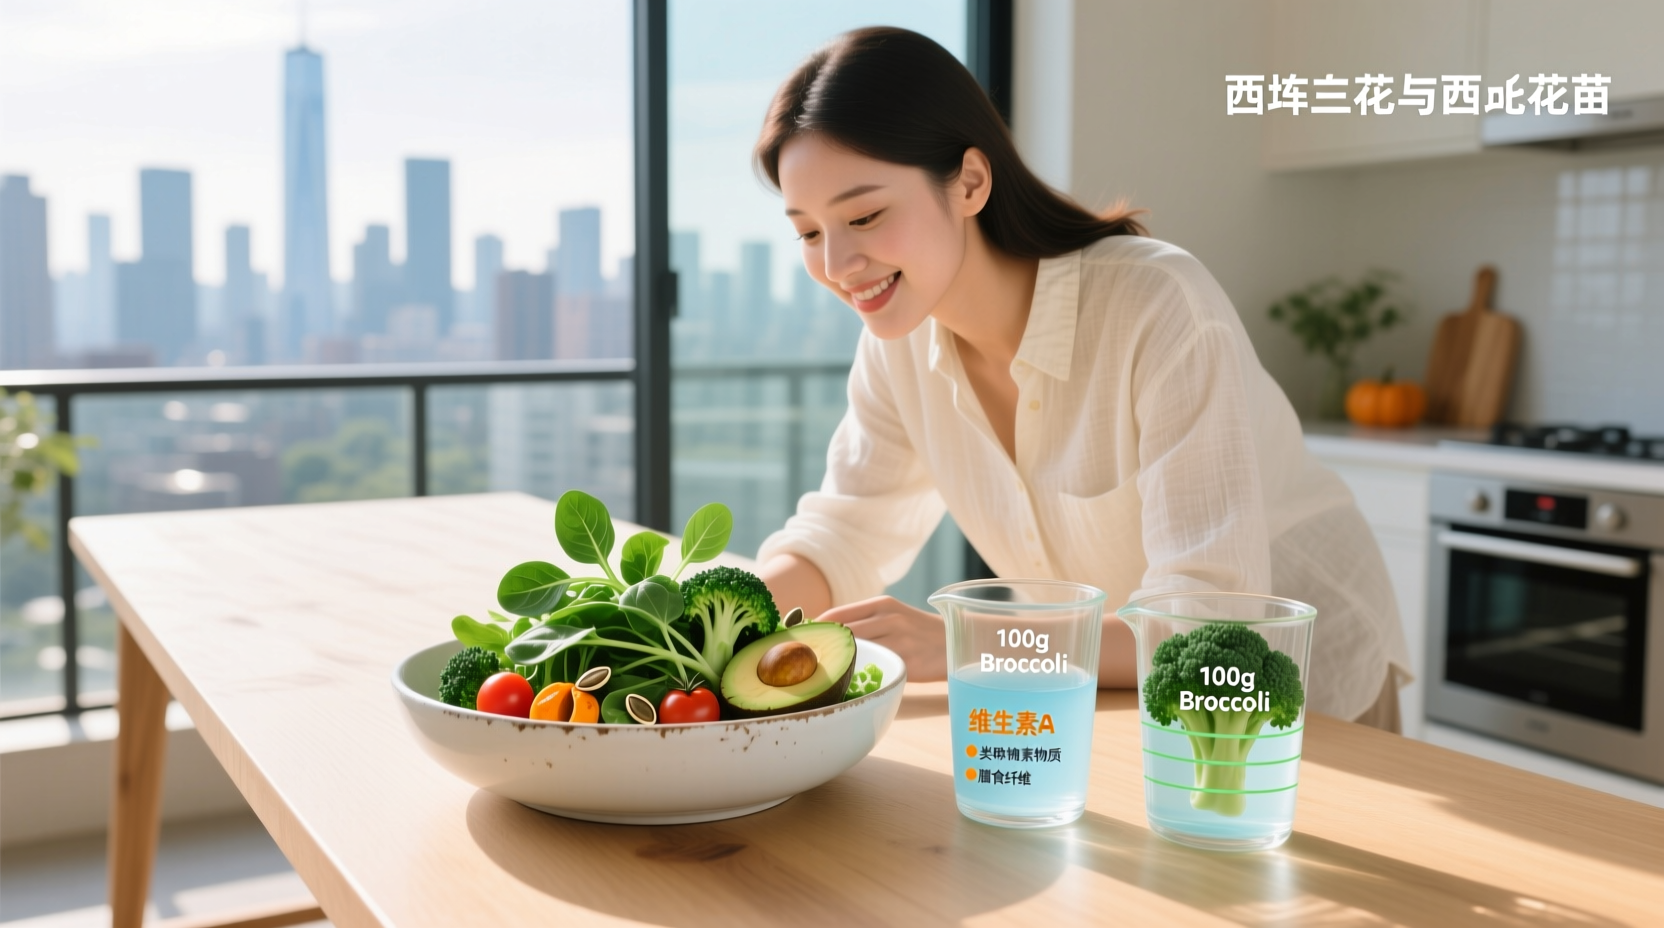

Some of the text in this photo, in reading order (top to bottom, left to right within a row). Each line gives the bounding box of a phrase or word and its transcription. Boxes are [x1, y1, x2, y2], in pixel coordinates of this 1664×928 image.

[997, 628, 1049, 653] 100g
[980, 652, 1068, 673] Broccoli
[1200, 666, 1255, 693] 100g
[1180, 690, 1270, 712] Broccoli
[968, 708, 1055, 736] 维生素A
